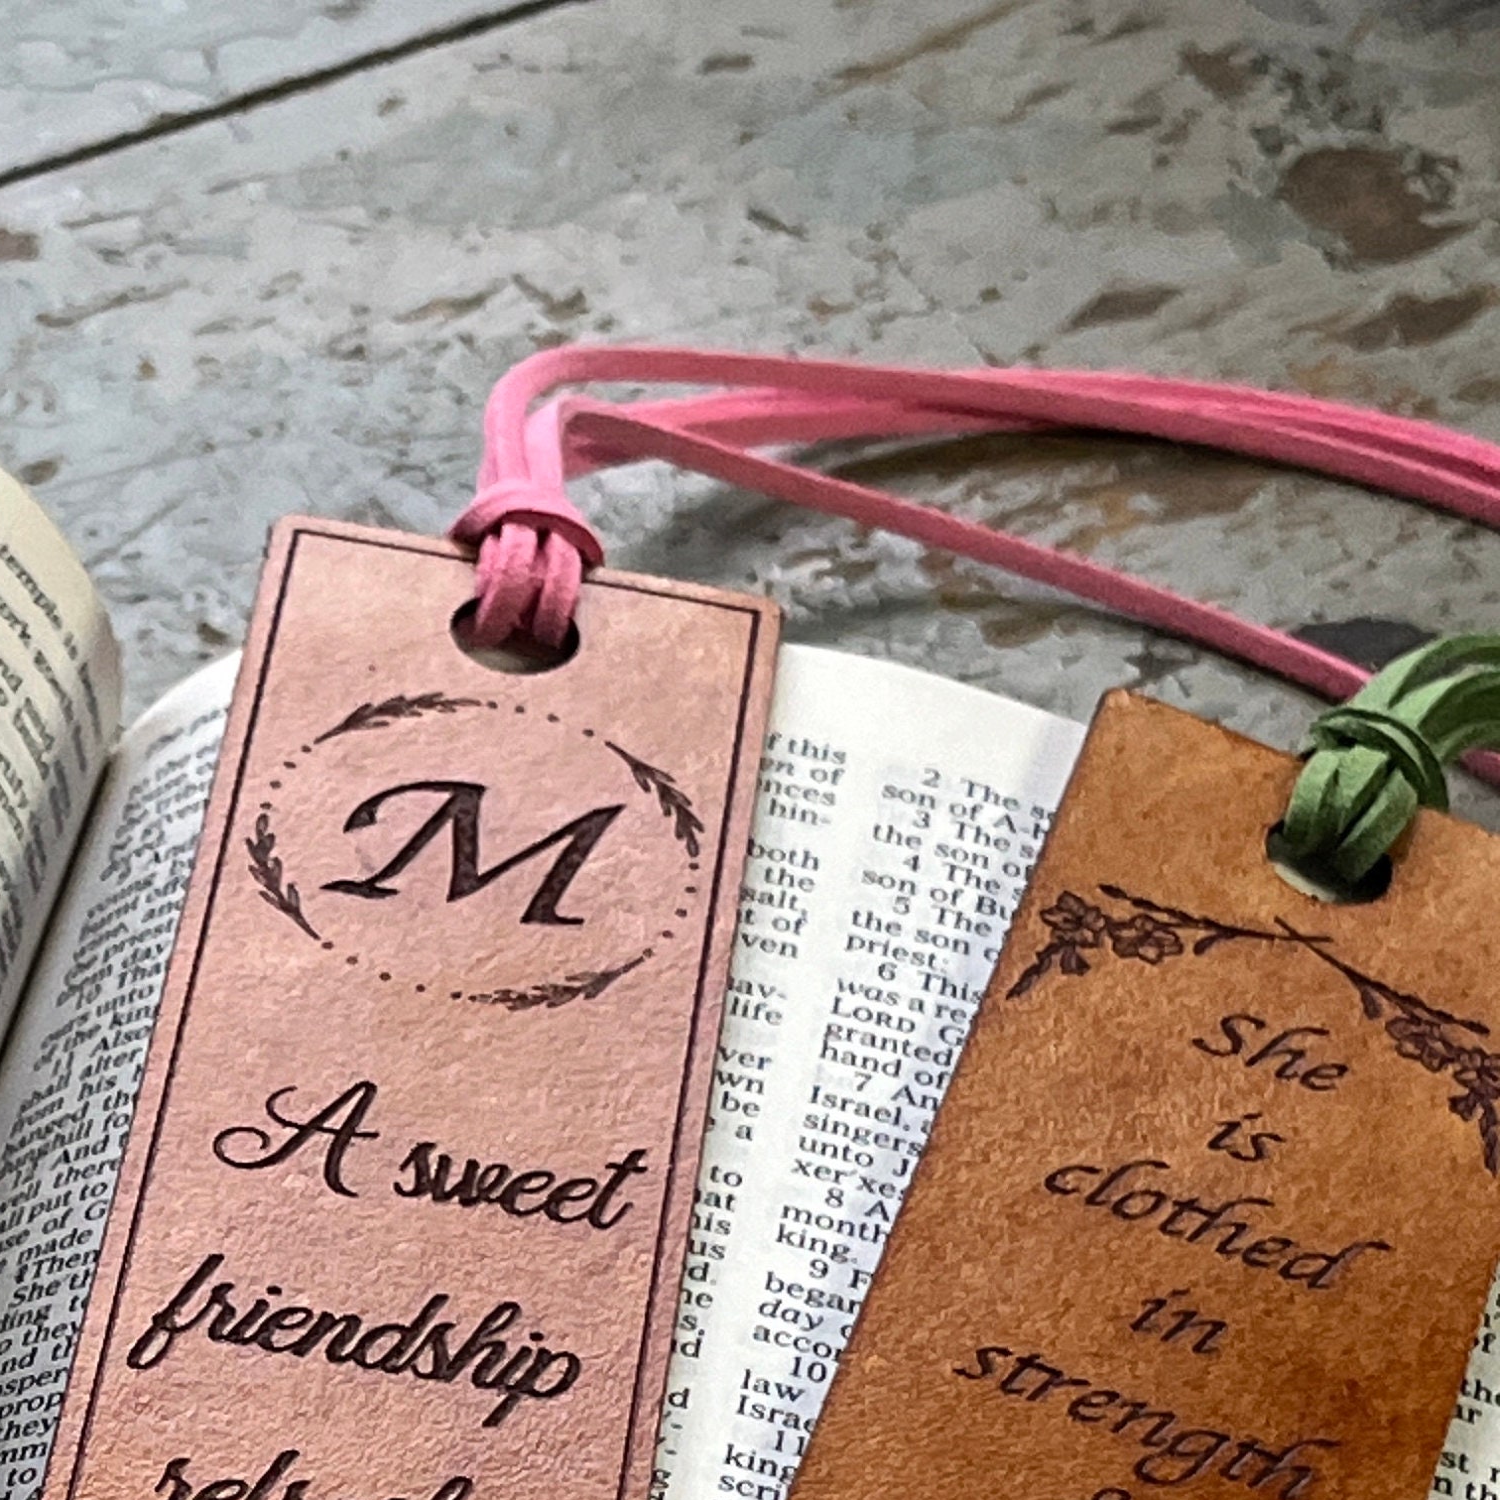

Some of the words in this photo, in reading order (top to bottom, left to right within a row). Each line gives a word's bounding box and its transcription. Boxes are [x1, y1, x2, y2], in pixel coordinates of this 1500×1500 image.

[319, 779, 627, 927] M
[819, 1046, 900, 1078] hand
[824, 1021, 953, 1067] granted
[212, 1080, 379, 1198] A
[393, 1140, 650, 1231] sweet
[800, 1134, 875, 1168] unto
[1206, 1108, 1285, 1164] is
[1043, 1157, 1393, 1291] clothed
[126, 1253, 583, 1428] friendship
[1127, 1287, 1229, 1358] in
